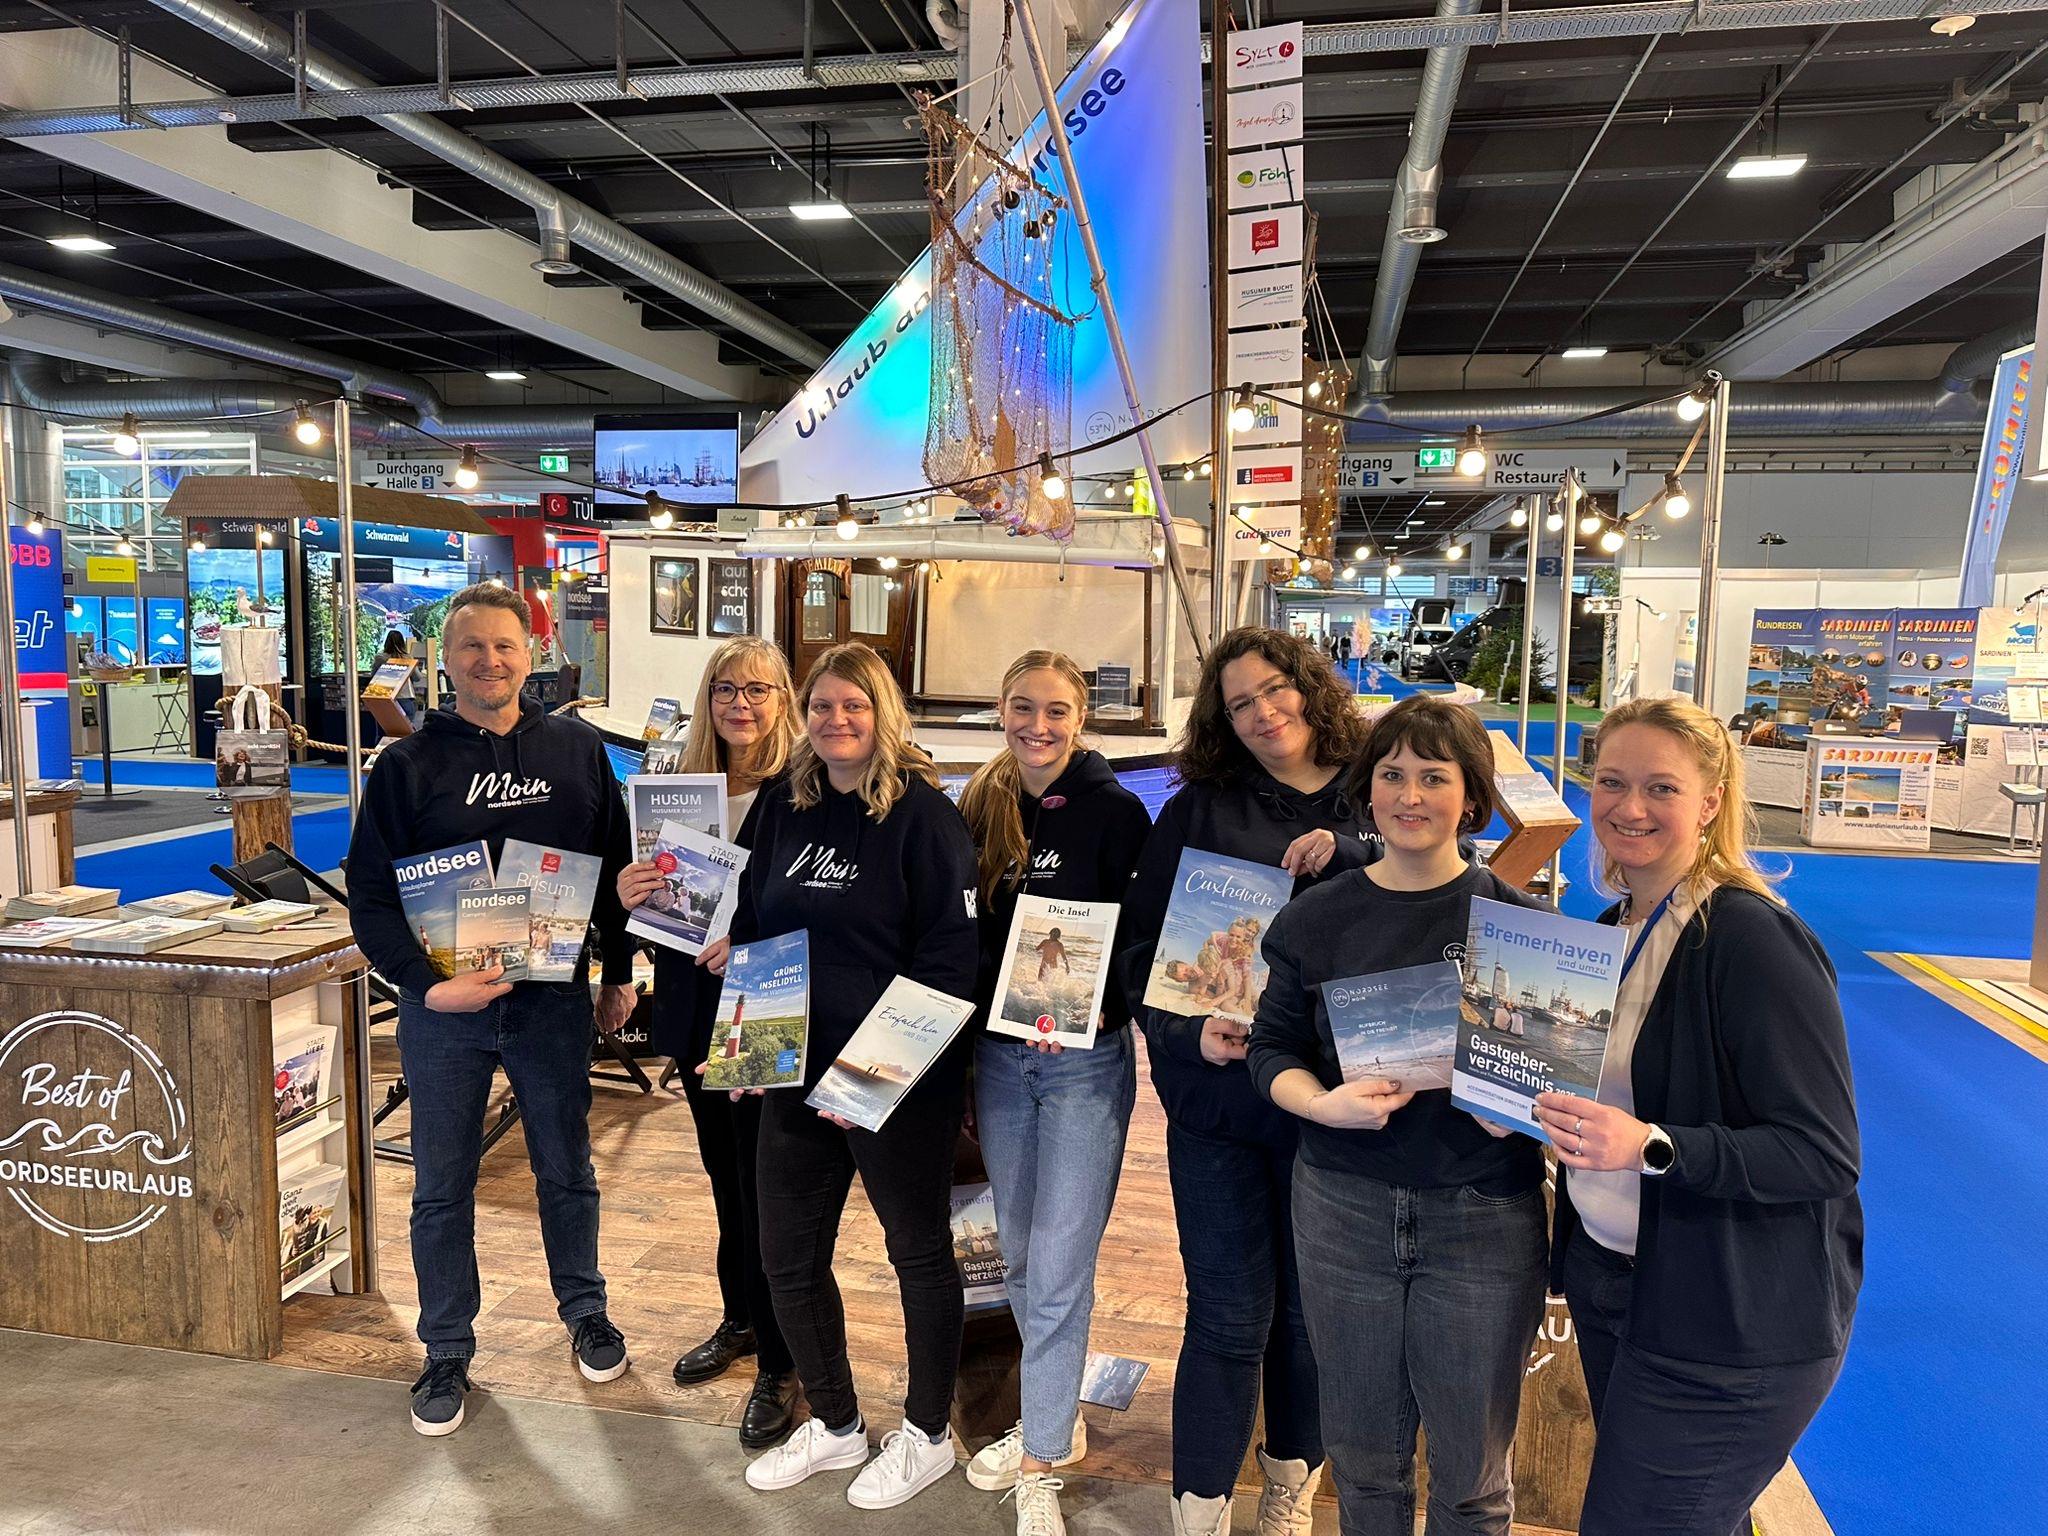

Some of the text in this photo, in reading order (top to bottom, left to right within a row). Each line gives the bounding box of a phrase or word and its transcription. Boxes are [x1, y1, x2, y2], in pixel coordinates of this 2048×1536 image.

[896, 291, 932, 333] an
[1984, 359, 2031, 534] RDINIEN
[1304, 456, 1392, 472] Duhgang
[1495, 453, 1524, 467] WC
[377, 462, 444, 478] Durchgang
[1494, 470, 1587, 484] Restaurat
[387, 477, 418, 489] Halle
[1316, 472, 1376, 486] Hlle 3
[222, 521, 287, 533] Schwaald
[1235, 527, 1291, 540] Cuxhaven
[365, 530, 410, 543] Schwarzwald
[1544, 559, 1556, 576] 3
[1476, 579, 1485, 591] 3
[1756, 619, 1802, 630] RUNDREISEN
[1820, 619, 1892, 633] SARDINIEN
[1898, 619, 1976, 633] SARDINIEN
[1849, 633, 1875, 641] Motorrad
[2006, 637, 2041, 645] MOB
[1980, 649, 2012, 657] SARDINIEN
[1823, 748, 1933, 764] SARDINIEN
[465, 772, 552, 806] Moin
[487, 800, 522, 809] nordsee
[651, 794, 702, 806] HUSUM
[1844, 821, 1928, 832] www.sardinienurlaub.ch
[711, 845, 739, 862] STADT
[396, 850, 481, 883] nordsee
[708, 854, 737, 871] LIEBE
[785, 843, 860, 880] Moin
[515, 872, 576, 898] Büsum
[801, 880, 828, 888] ordsee
[461, 893, 526, 909] nordsee
[1048, 904, 1091, 917] Die Insel
[1483, 920, 1612, 967] Bremerhaven
[774, 964, 803, 978] GRÜNES
[1557, 957, 1606, 976] und umzu
[759, 975, 802, 990] INSELIDYLL
[1350, 983, 1389, 996] NORDSEE
[878, 1005, 938, 1035] Einfach hin
[305, 1043, 325, 1056] LIEBE
[306, 1036, 327, 1049] STADT
[1470, 1033, 1554, 1073] Gastgeber-
[1468, 1050, 1554, 1094] verzeichnis
[22, 1063, 131, 1120] Best of
[0, 1159, 193, 1198] ORDSEEURLAUB
[283, 1187, 303, 1202] Ganz
[280, 1203, 299, 1218] oben
[963, 1258, 1008, 1273] Gastgebe
[965, 1266, 1009, 1282] verzeich
